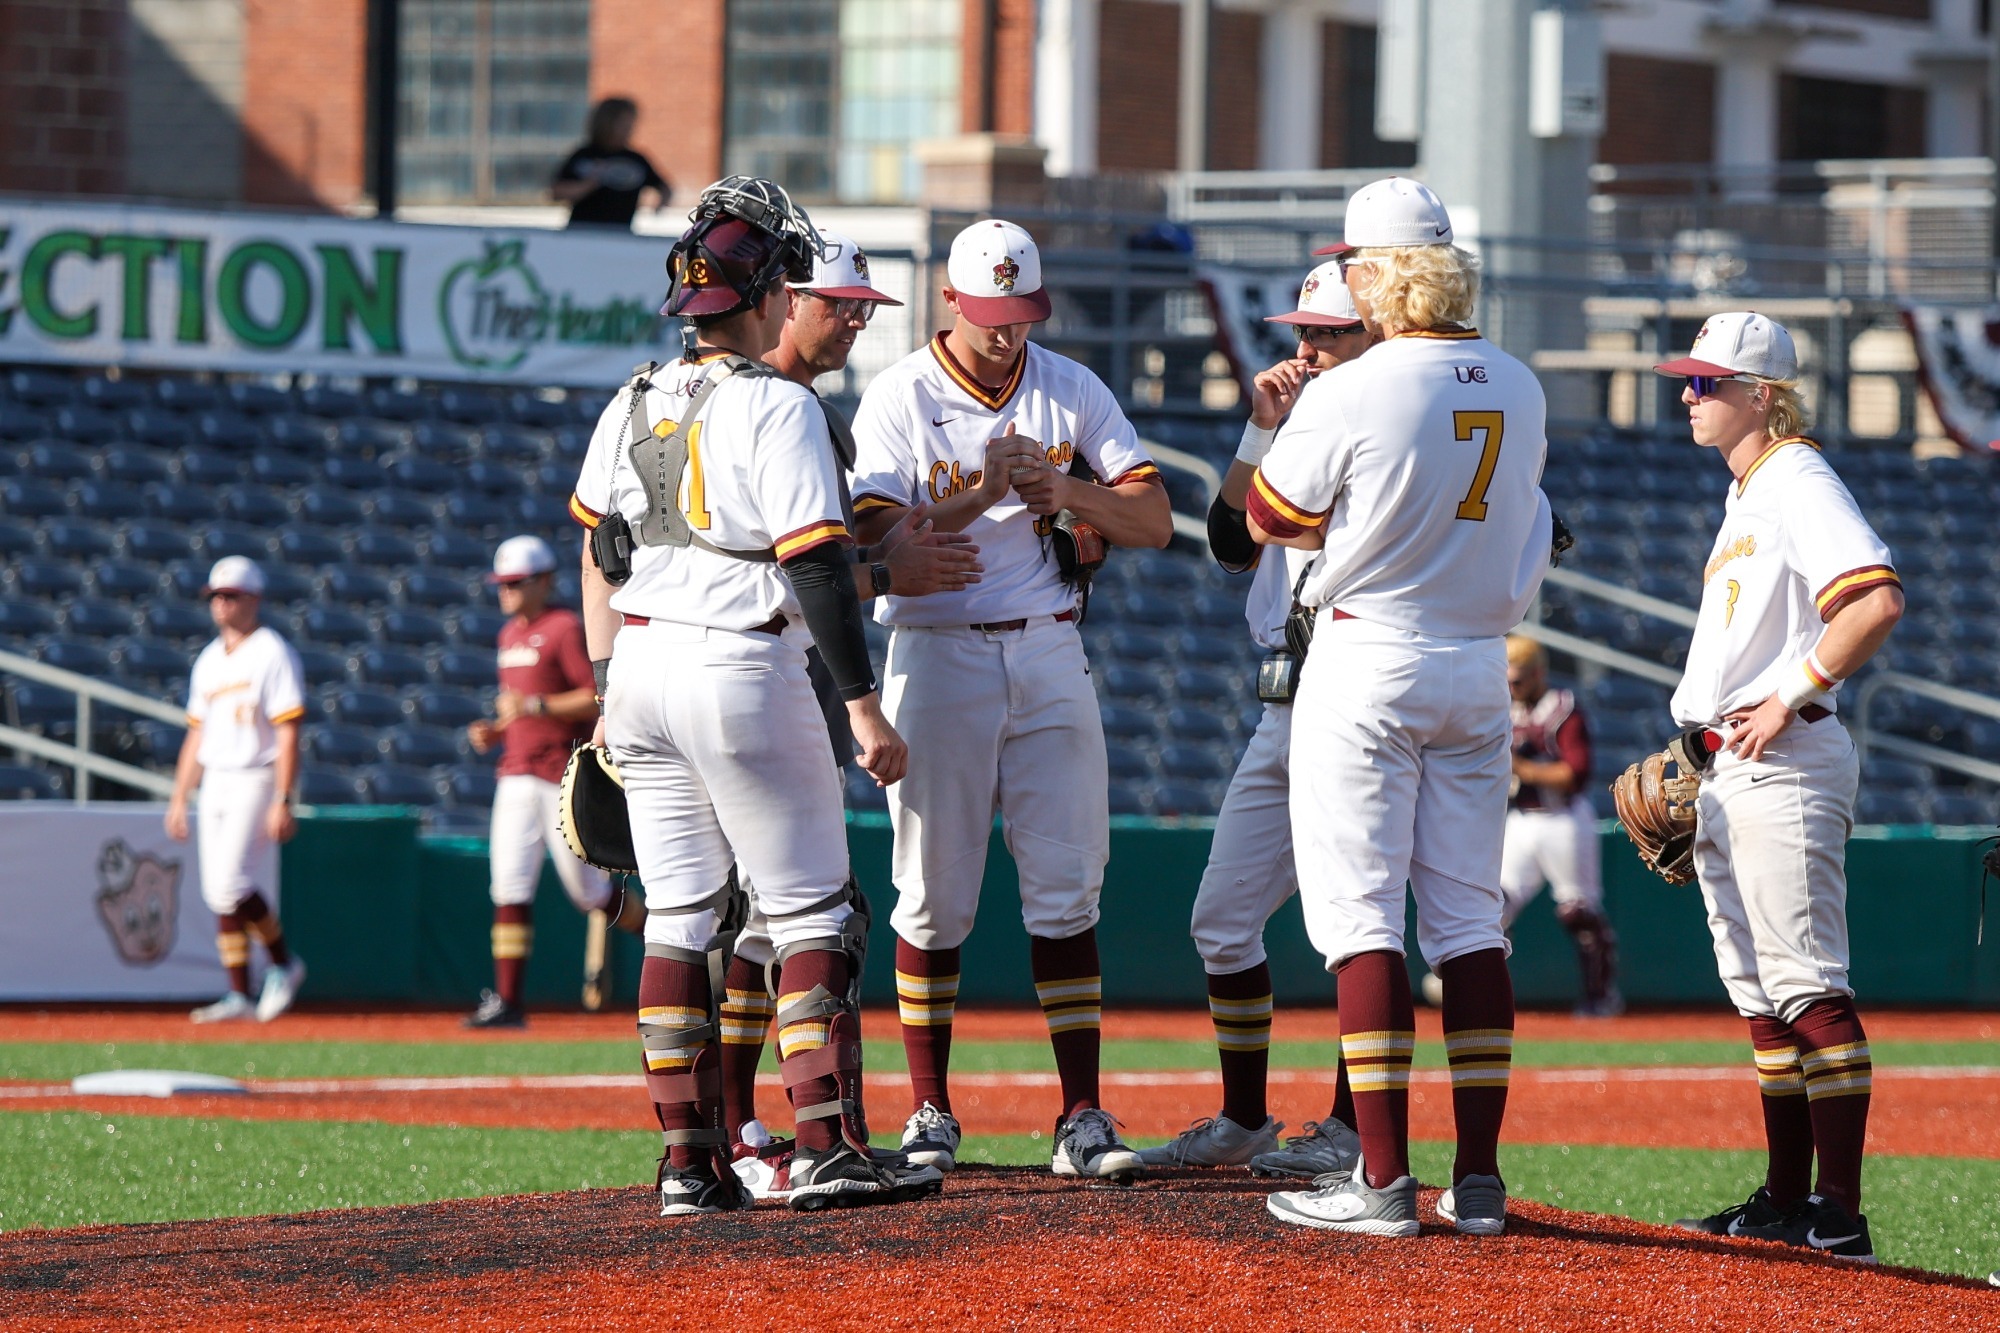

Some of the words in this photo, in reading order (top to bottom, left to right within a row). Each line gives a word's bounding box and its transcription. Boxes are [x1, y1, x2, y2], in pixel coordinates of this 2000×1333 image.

[0, 227, 405, 353] CTION
[1454, 366, 1489, 384] UC
[1452, 410, 1505, 522] 7
